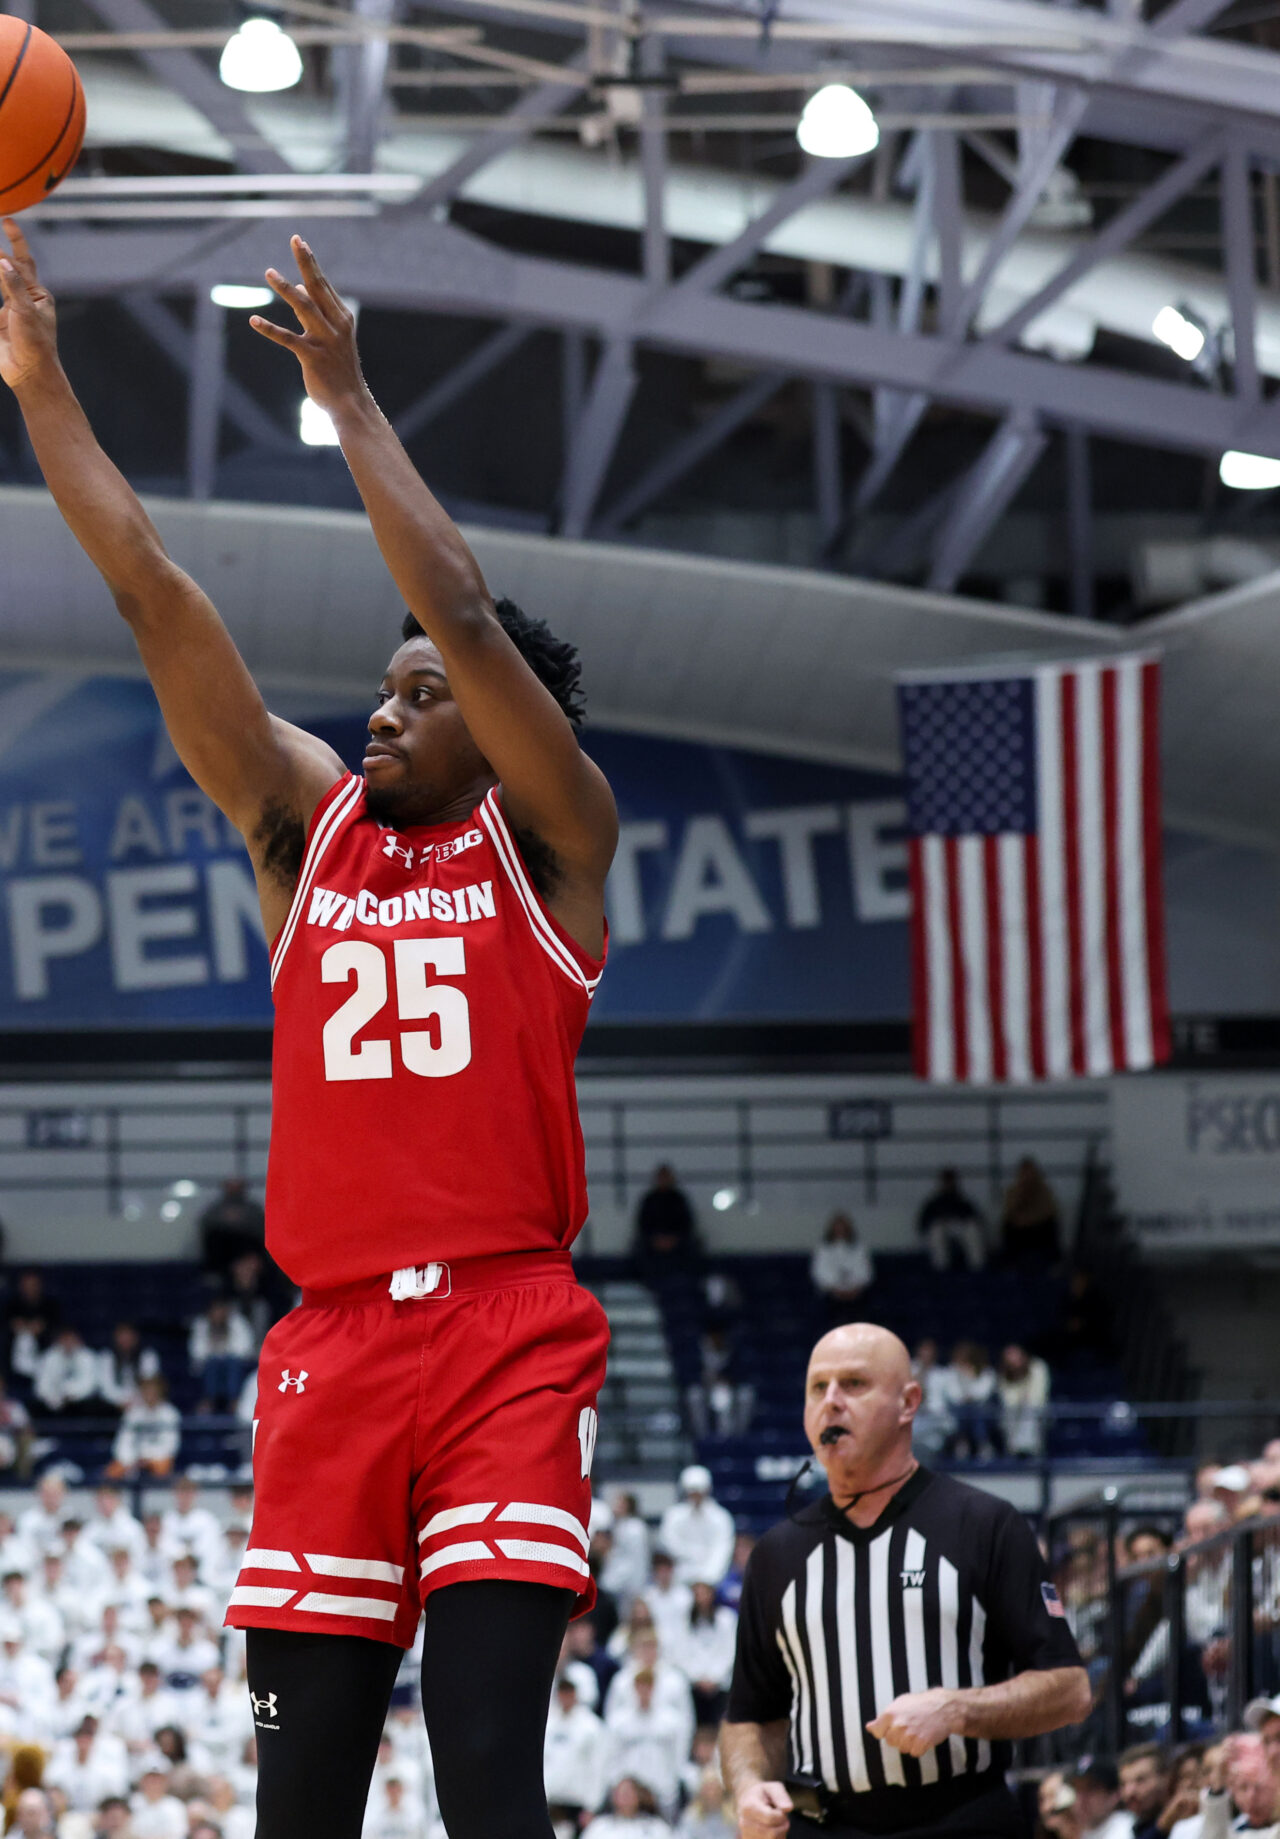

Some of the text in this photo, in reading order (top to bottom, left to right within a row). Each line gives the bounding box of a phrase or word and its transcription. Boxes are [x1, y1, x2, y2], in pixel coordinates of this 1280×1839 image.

[306, 880, 497, 932] WICONSIN
[321, 936, 472, 1081] 25
[899, 1569, 927, 1588] TW
